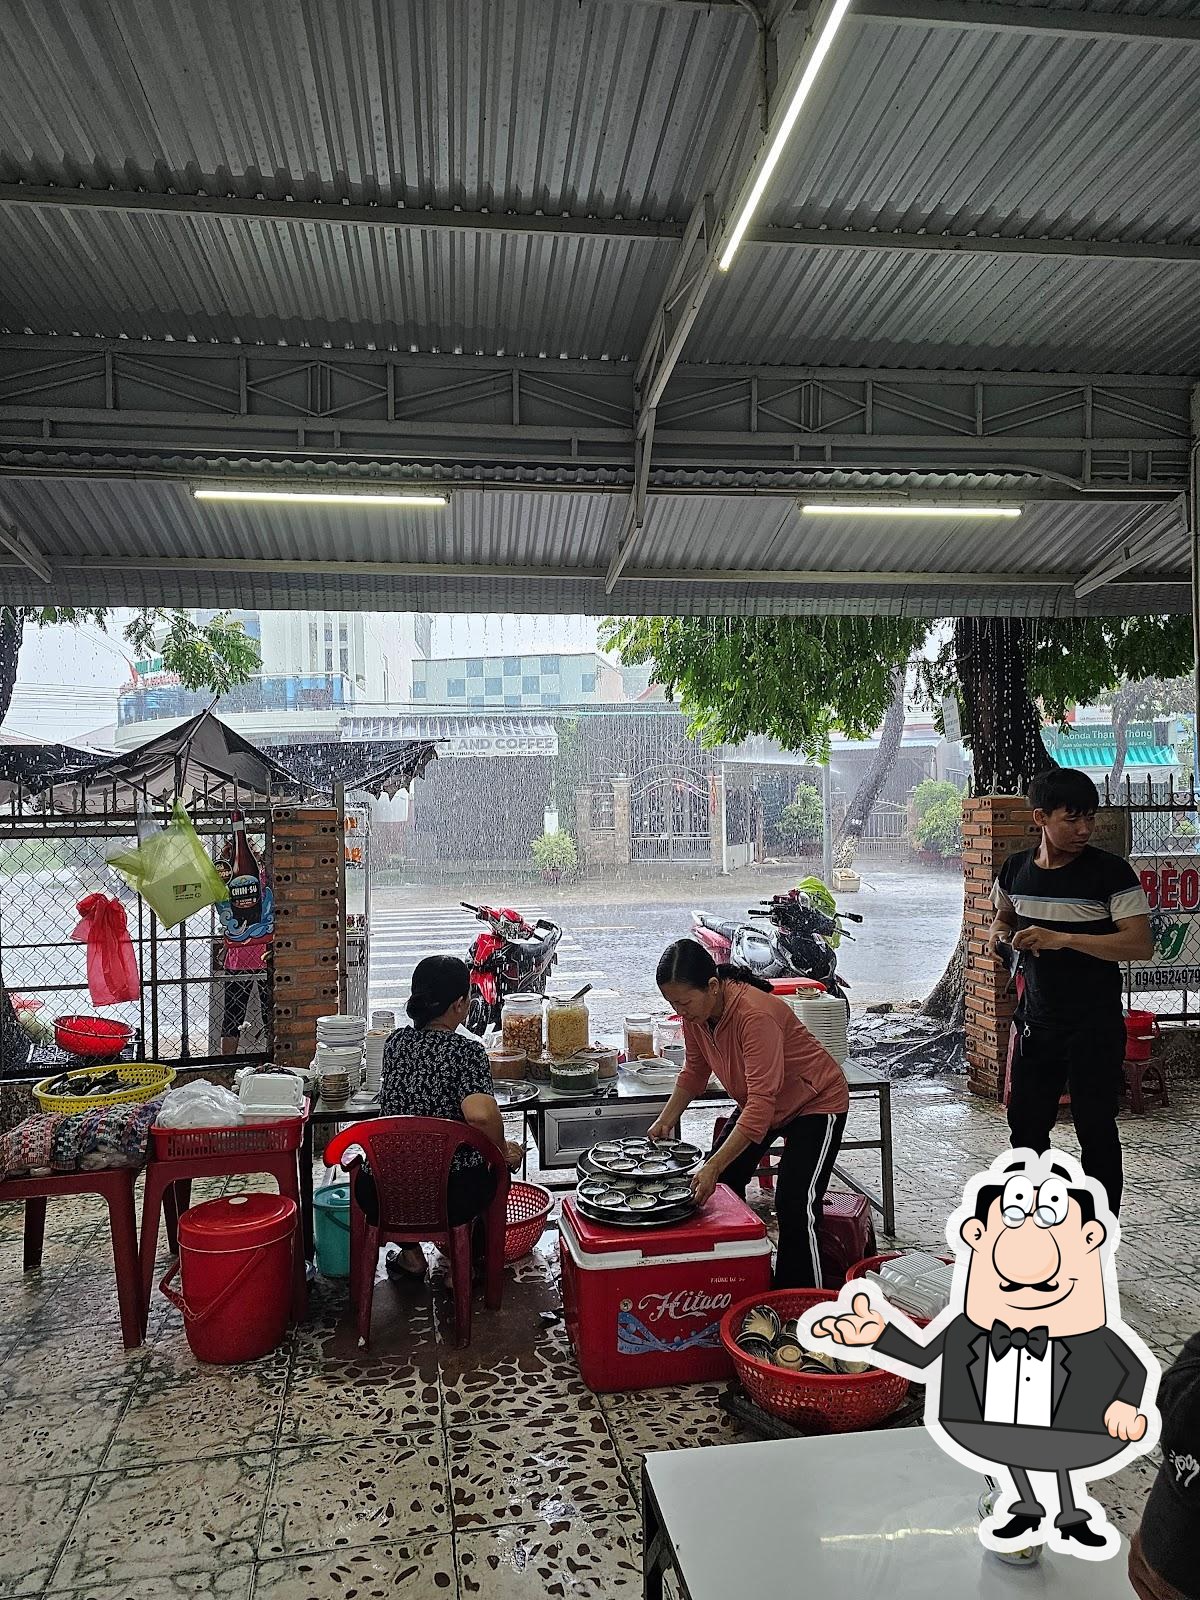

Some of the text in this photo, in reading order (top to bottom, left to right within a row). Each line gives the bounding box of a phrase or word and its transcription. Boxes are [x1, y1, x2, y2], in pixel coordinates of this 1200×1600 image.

[458, 738, 490, 750] AND
[495, 738, 554, 749] COFFEE
[1140, 862, 1200, 911] BÈO
[1135, 968, 1200, 987] 0949524979
